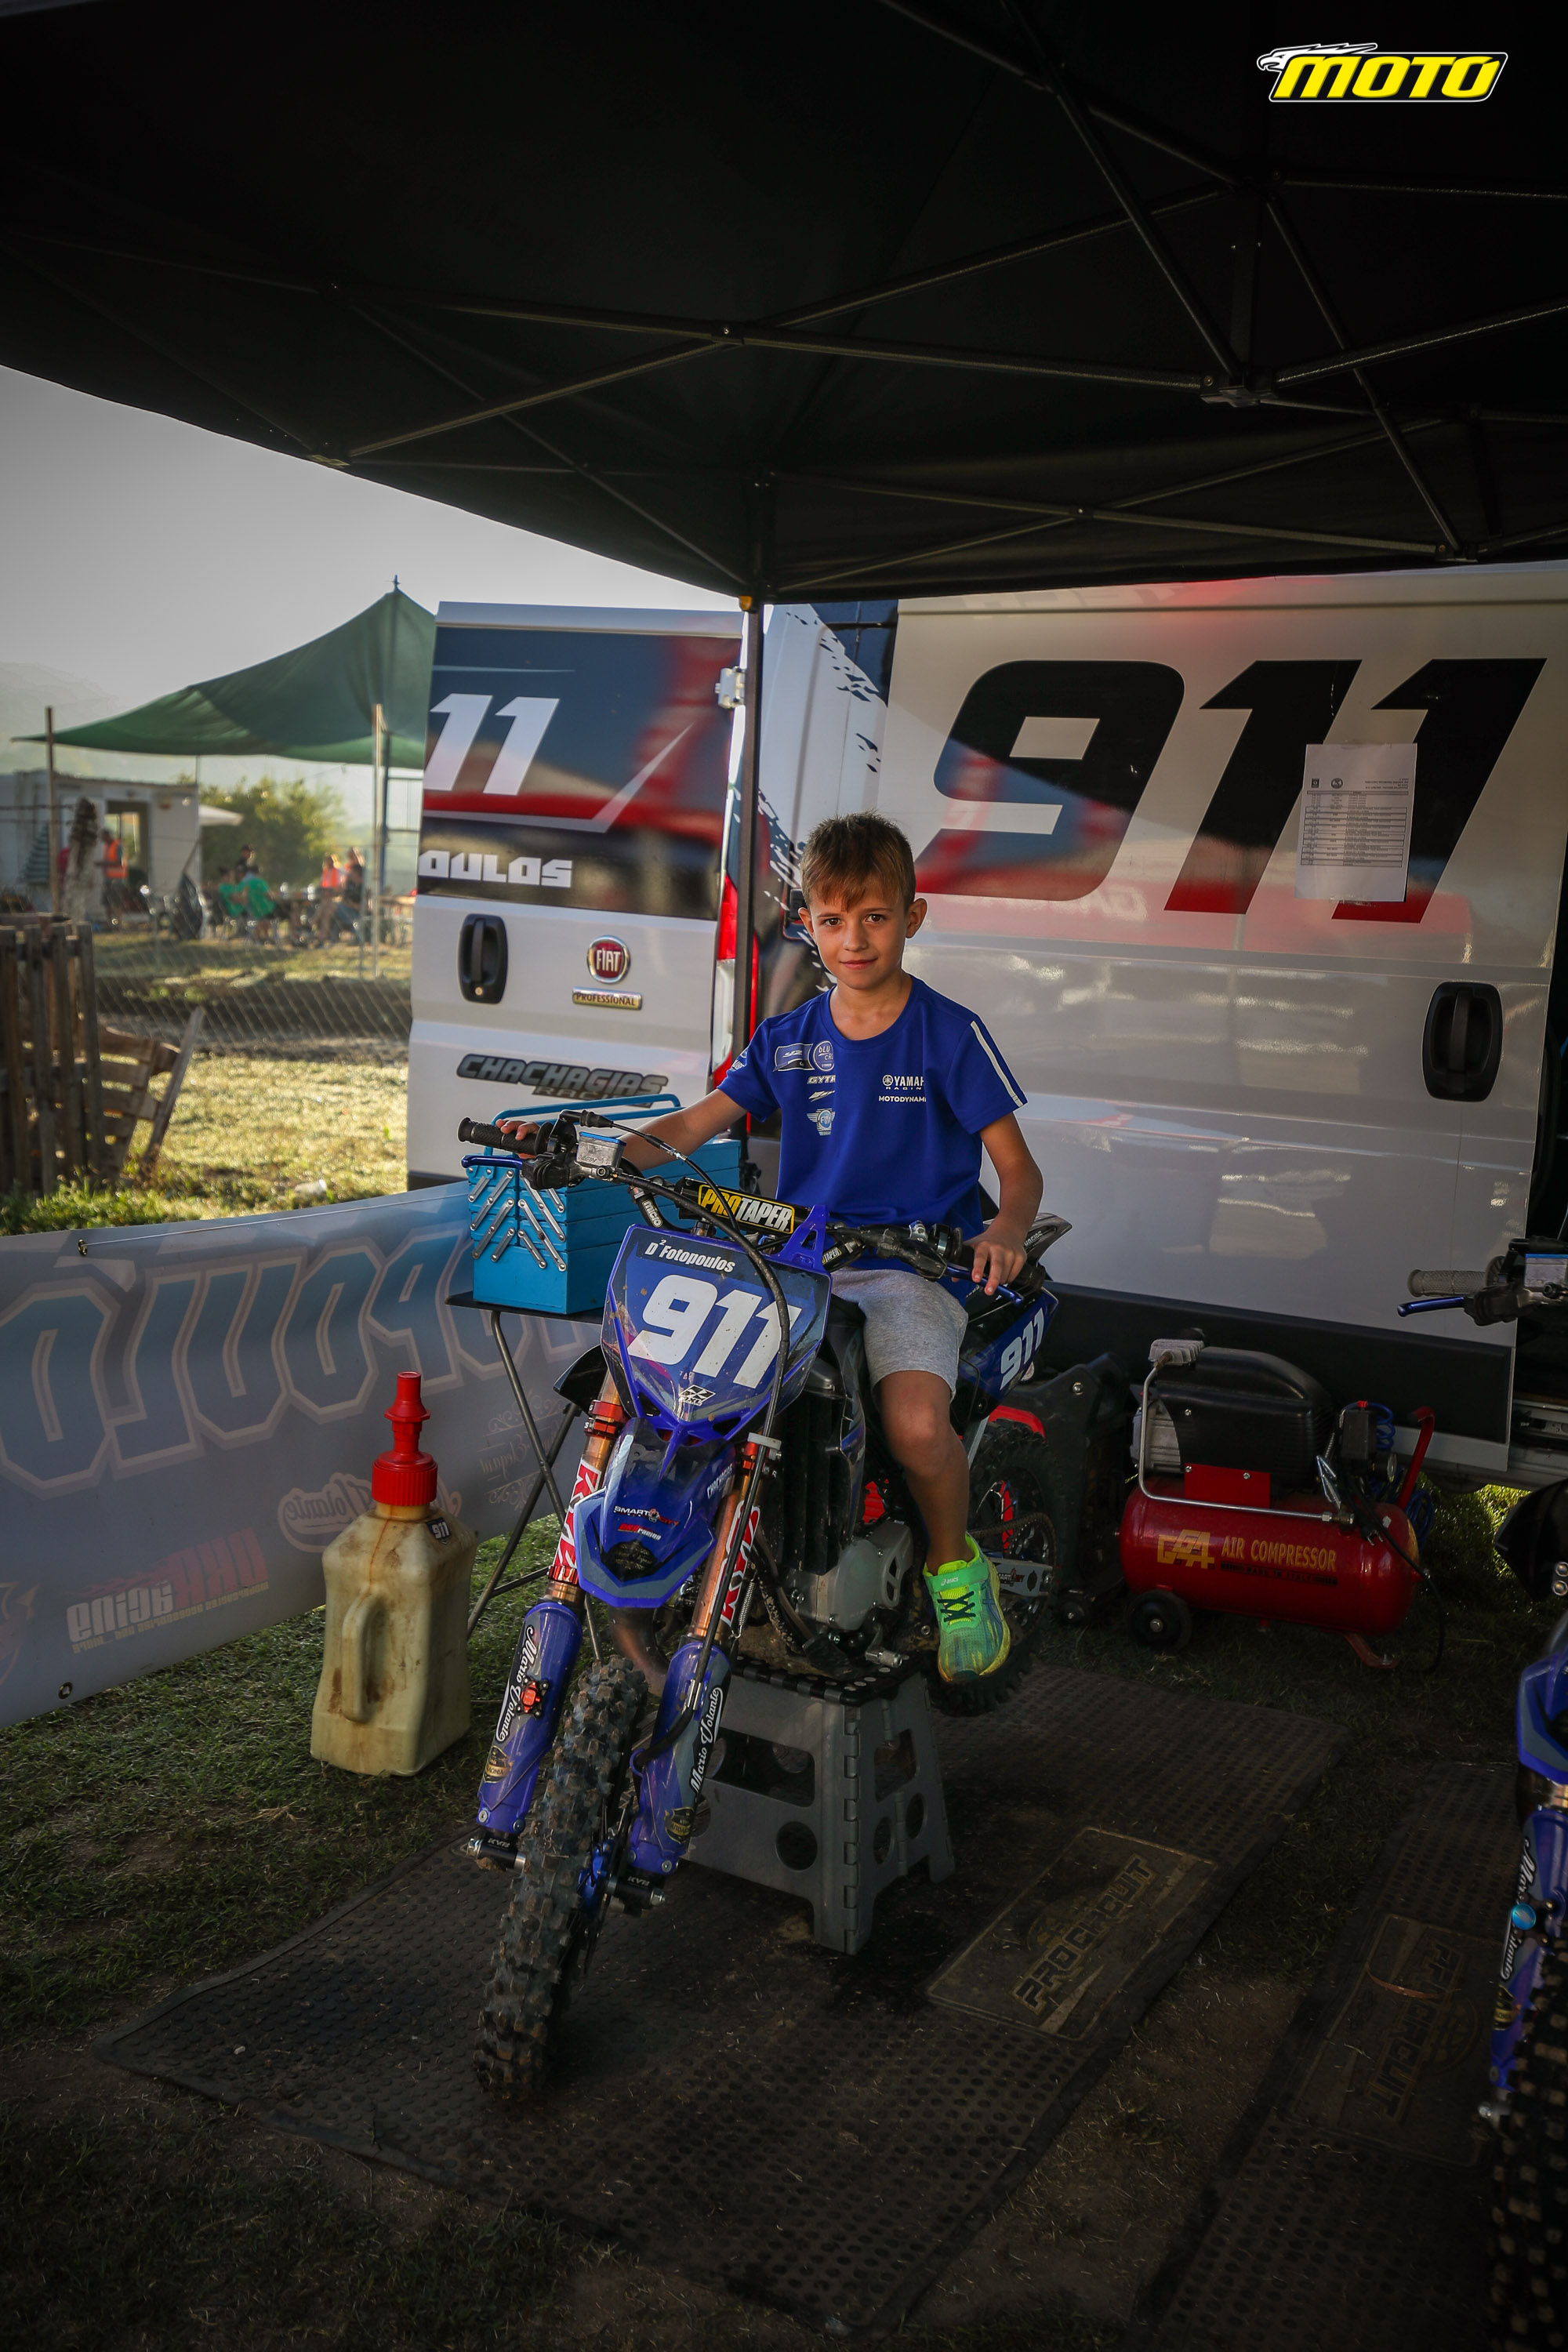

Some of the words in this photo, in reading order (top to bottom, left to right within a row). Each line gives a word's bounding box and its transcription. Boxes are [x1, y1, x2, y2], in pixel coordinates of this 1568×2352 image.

[424, 693, 560, 796] 11
[914, 657, 1548, 924] 911
[596, 948, 622, 972] FIAT
[575, 993, 637, 1006] PROFESSIONAL
[459, 1054, 668, 1096] CHACHAGIAS
[627, 1274, 802, 1389] 911
[1000, 1308, 1044, 1391] 911
[431, 1522, 450, 1539] 911
[1221, 1536, 1245, 1559] AIR
[1250, 1539, 1338, 1572] COMPRESSOR
